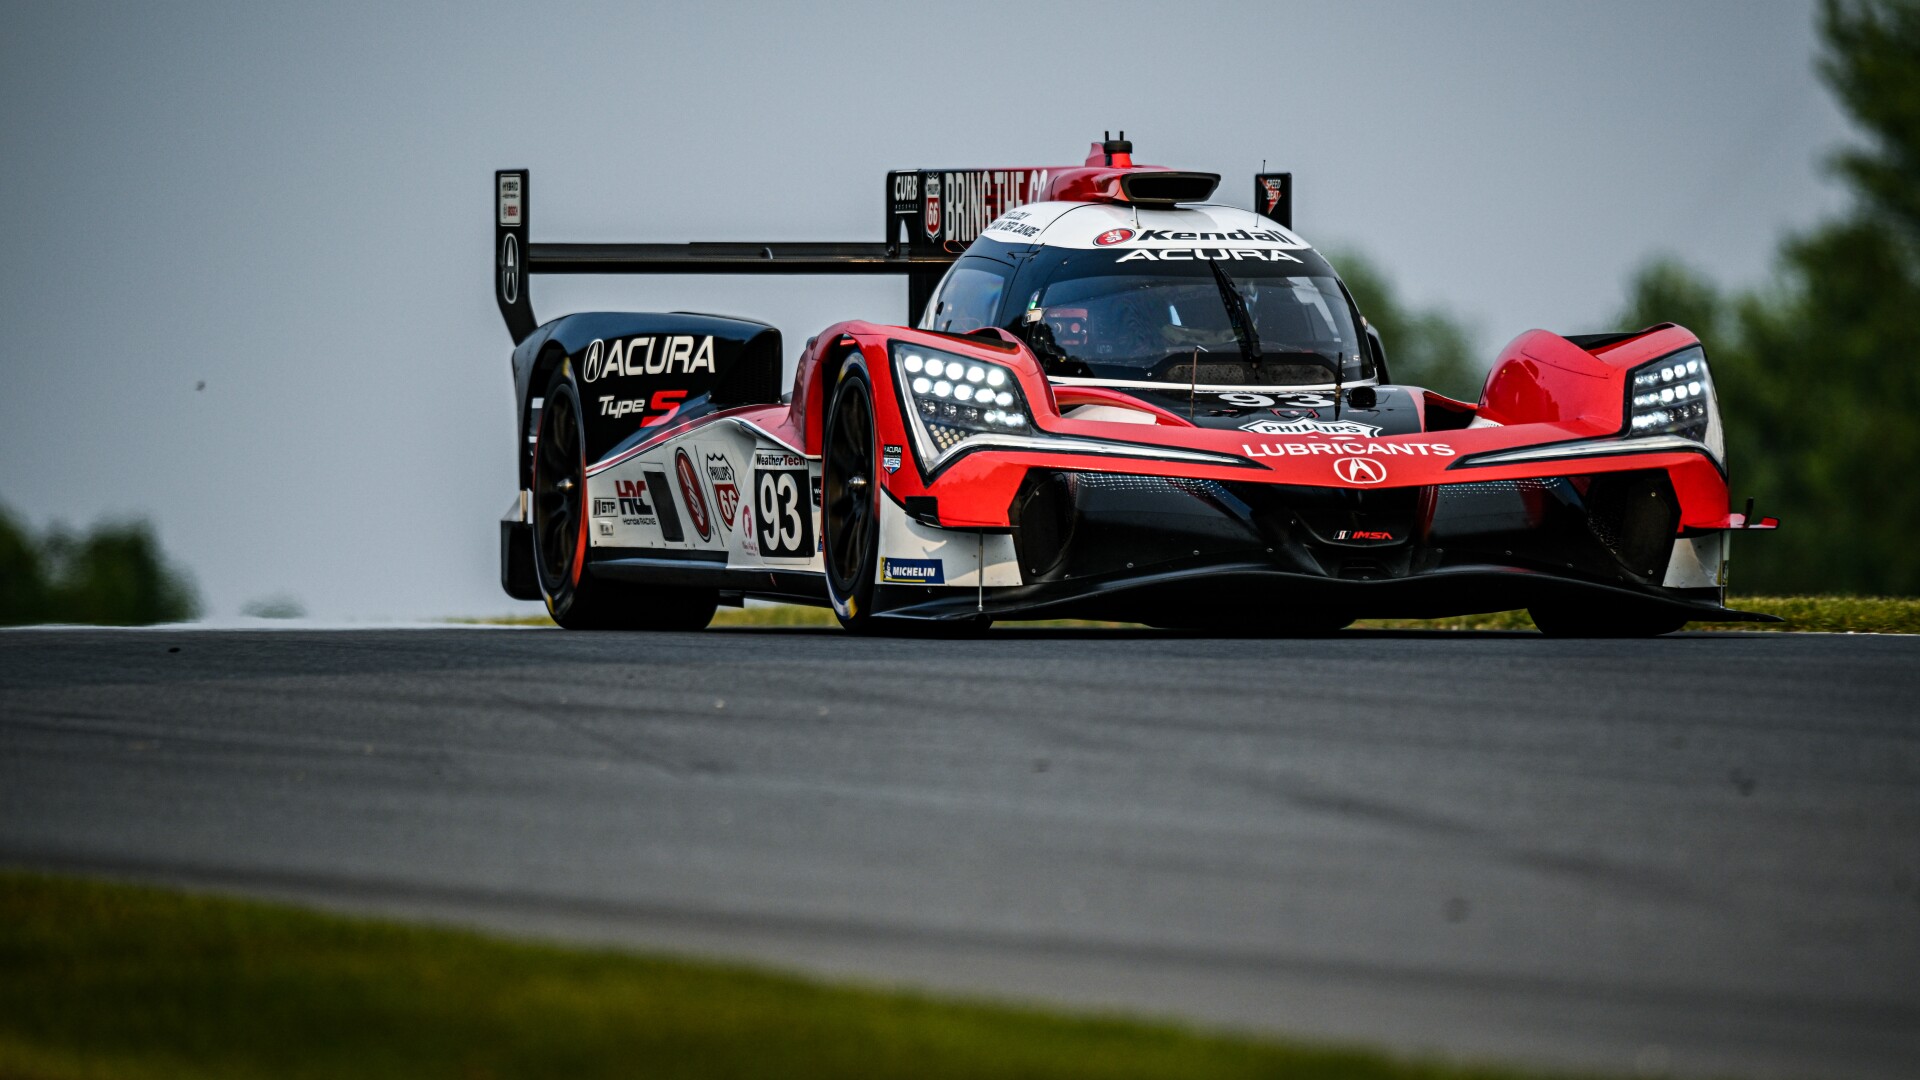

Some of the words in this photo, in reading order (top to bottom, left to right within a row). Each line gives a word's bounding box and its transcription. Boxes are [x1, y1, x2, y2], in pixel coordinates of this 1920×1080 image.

[895, 175, 918, 201] CURB
[928, 202, 938, 226] 66
[946, 171, 991, 242] BRING
[1138, 229, 1298, 246] Kendall
[1115, 248, 1304, 264] ACURA
[601, 335, 716, 379] ACURA
[1218, 393, 1335, 407] 93
[599, 395, 646, 419] Type
[640, 389, 688, 428] S
[1262, 423, 1358, 434] PHILLIPS
[886, 446, 902, 454] ACURA
[1242, 443, 1456, 457] LUBRICANTS
[756, 454, 806, 466] WeatherTech
[883, 457, 901, 466] MSR
[709, 466, 732, 481] PHILLIPS
[602, 501, 616, 513] GTP
[719, 489, 739, 520] 66
[760, 472, 803, 552] 93
[1352, 531, 1393, 540] IMSA
[893, 566, 936, 577] MICHELIN
